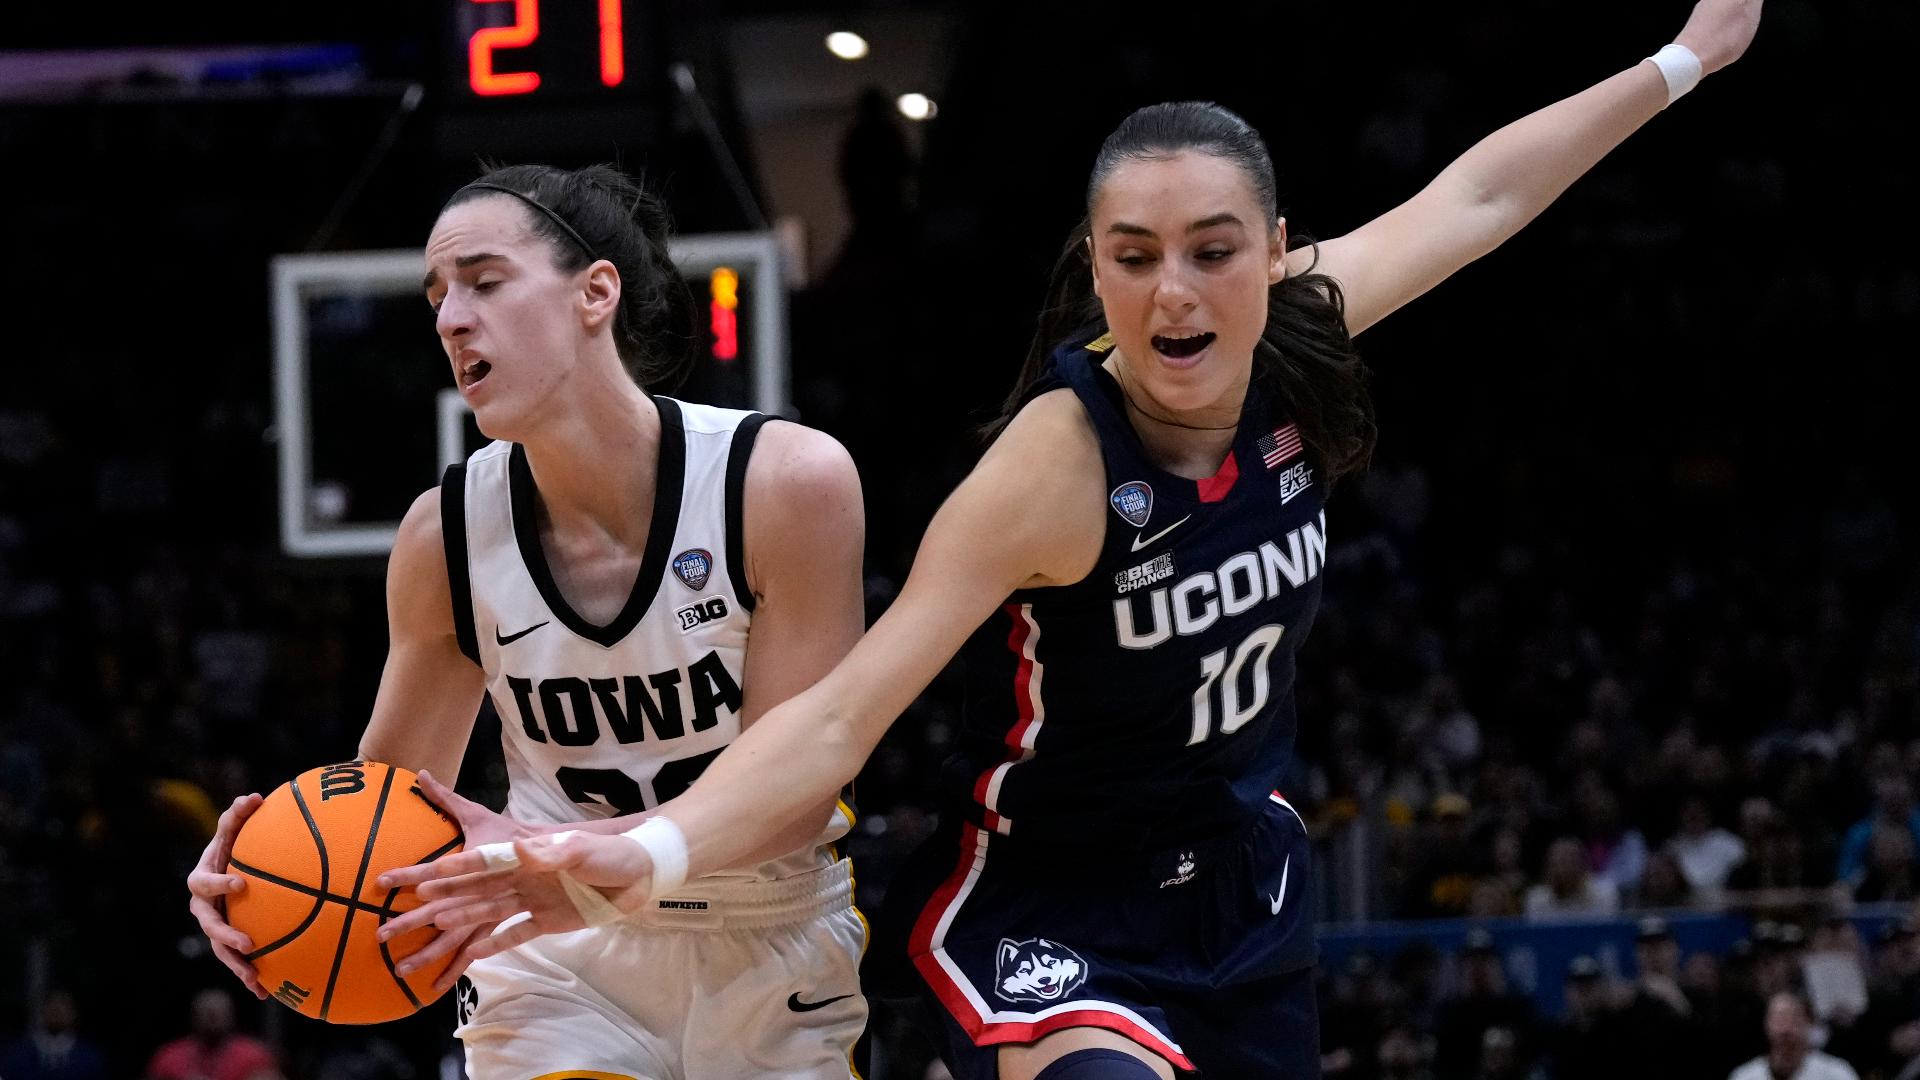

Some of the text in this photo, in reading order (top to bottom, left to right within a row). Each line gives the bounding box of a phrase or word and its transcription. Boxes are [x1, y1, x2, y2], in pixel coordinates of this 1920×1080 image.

[1280, 461, 1305, 486] BIG
[1280, 469, 1313, 499] EAST
[1121, 491, 1142, 505] FINAL
[1124, 499, 1146, 514] FOUR
[681, 557, 705, 570] FINAL
[684, 565, 706, 579] FOUR
[1113, 508, 1327, 650] UCONN
[1117, 565, 1174, 594] CHANGE
[1185, 623, 1285, 747] 10
[505, 649, 743, 747] IOWA
[658, 900, 708, 910] HAWKEYES
